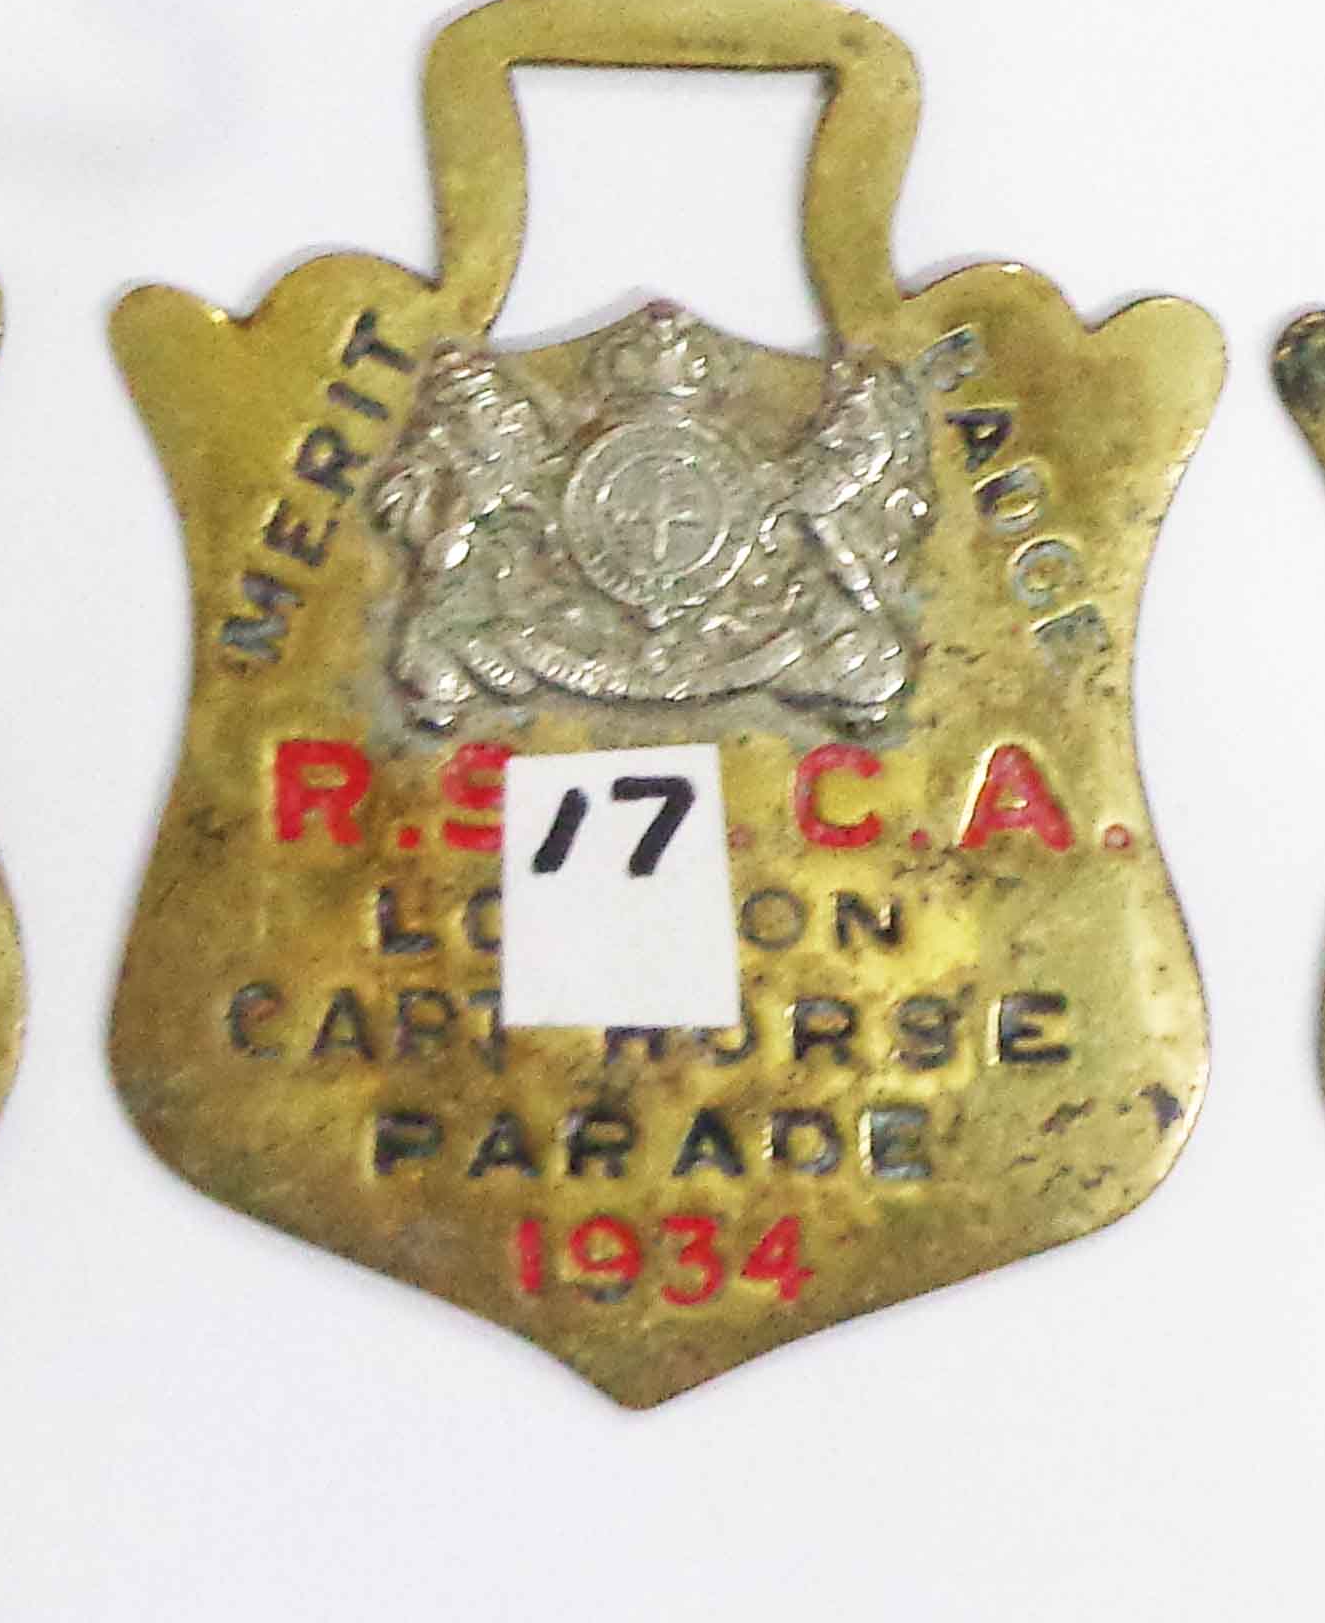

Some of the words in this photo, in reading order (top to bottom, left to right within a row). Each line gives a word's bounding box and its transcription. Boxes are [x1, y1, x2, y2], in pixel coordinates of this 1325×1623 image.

[218, 308, 421, 666] MERIT
[920, 324, 1109, 673] BADGE
[531, 777, 696, 879] 17
[374, 885, 906, 957] LOON
[374, 1105, 936, 1182] PARADE
[512, 1212, 816, 1308] 1934
